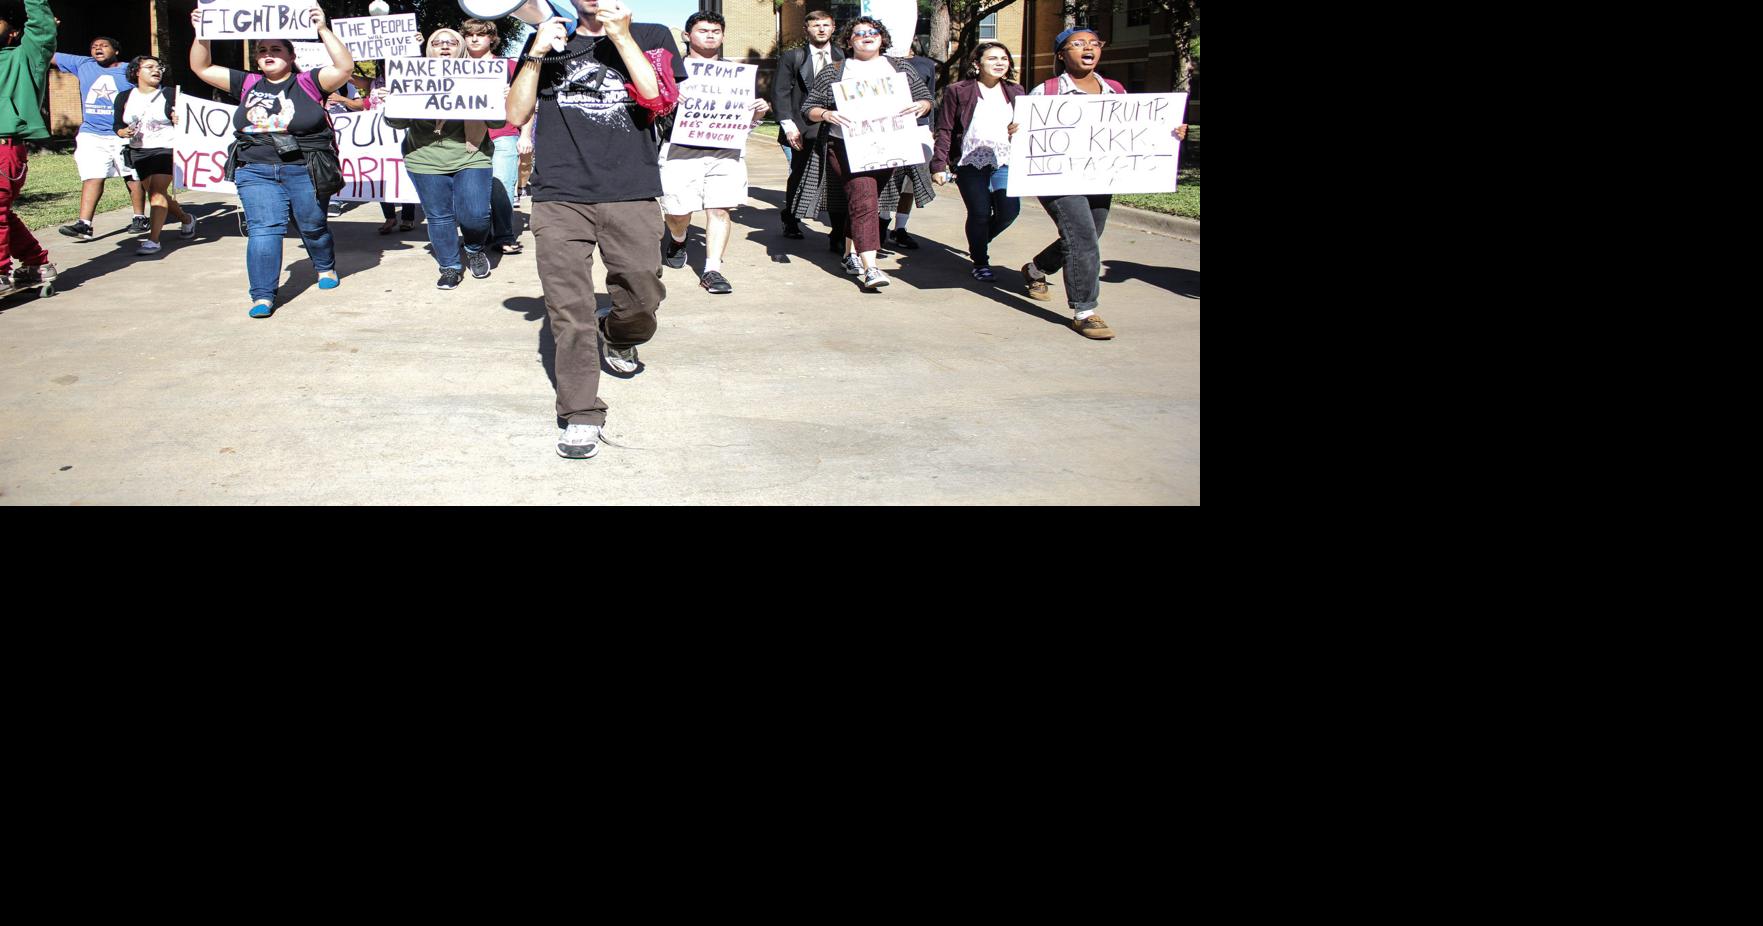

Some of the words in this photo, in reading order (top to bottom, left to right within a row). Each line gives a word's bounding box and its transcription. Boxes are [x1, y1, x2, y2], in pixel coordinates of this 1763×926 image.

[201, 5, 275, 37] FIGHT
[334, 21, 366, 38] THE
[371, 18, 416, 35] PEOPLE
[385, 36, 412, 47] GIVE
[391, 45, 408, 56] UP!
[389, 59, 436, 77] MAKE
[442, 60, 504, 76] RACISTS
[691, 62, 745, 78] TRUMP
[390, 78, 455, 94] AFRAID
[731, 87, 751, 97] NOT
[425, 93, 495, 111] AGAIN.
[684, 97, 716, 111] GRAB
[725, 100, 745, 110] OUR
[185, 102, 231, 137] NO
[1029, 100, 1083, 131] NO
[1088, 97, 1169, 125] TRUMP.
[709, 122, 748, 131] GRABBED
[1029, 129, 1070, 156] NO
[1089, 126, 1156, 153] KKK.
[176, 150, 228, 188] YES
[1029, 156, 1063, 173] NO
